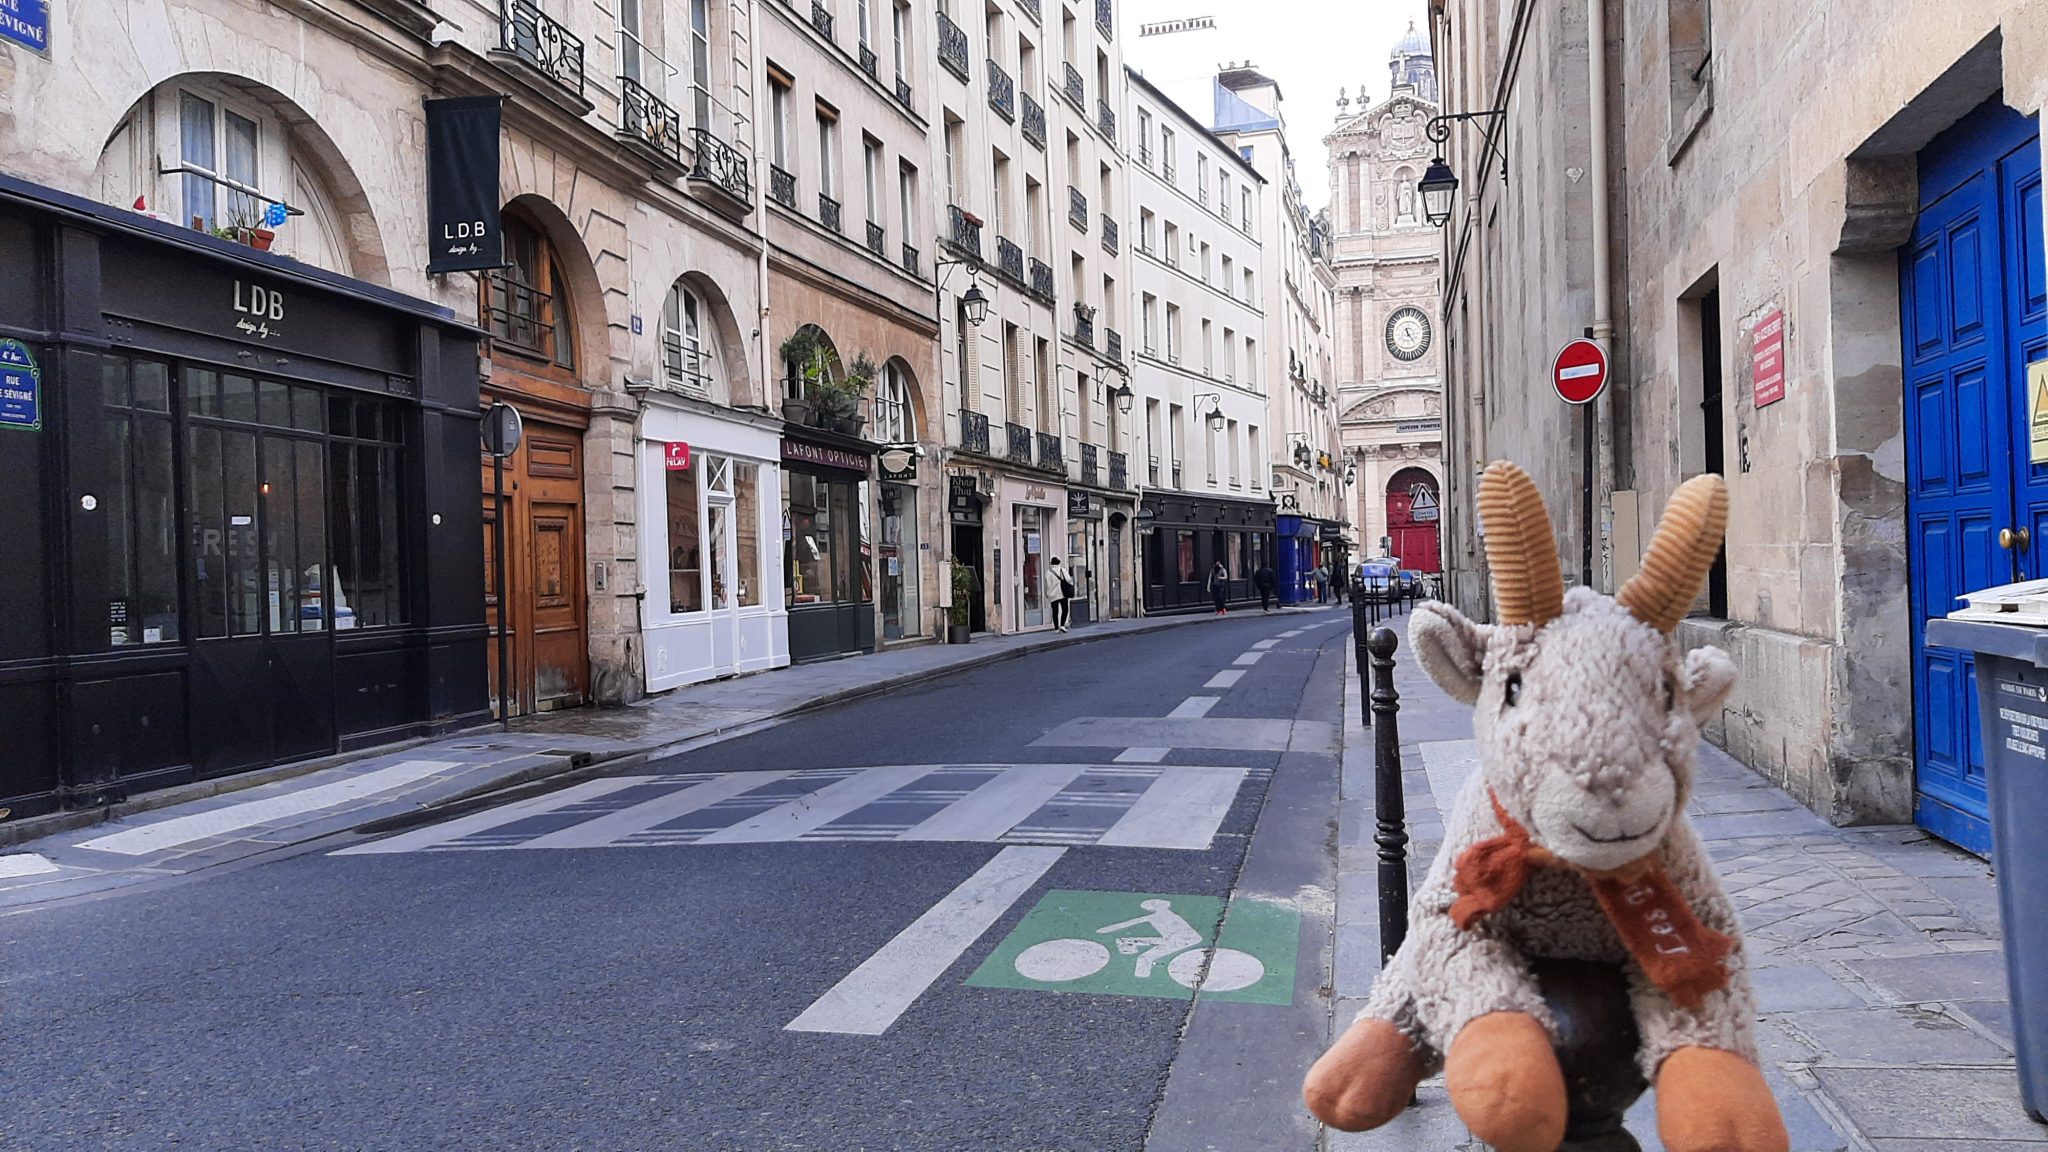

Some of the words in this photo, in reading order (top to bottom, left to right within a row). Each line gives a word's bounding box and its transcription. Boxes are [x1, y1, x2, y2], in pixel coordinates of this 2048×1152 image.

[0, 0, 19, 12] UE
[0, 9, 44, 43] ÉVIGNÉ
[233, 279, 284, 321] LDB
[5, 375, 20, 386] RUE
[785, 441, 824, 461] LAFONT
[827, 449, 869, 470] OPTICIEN
[884, 472, 913, 480] LAFONT
